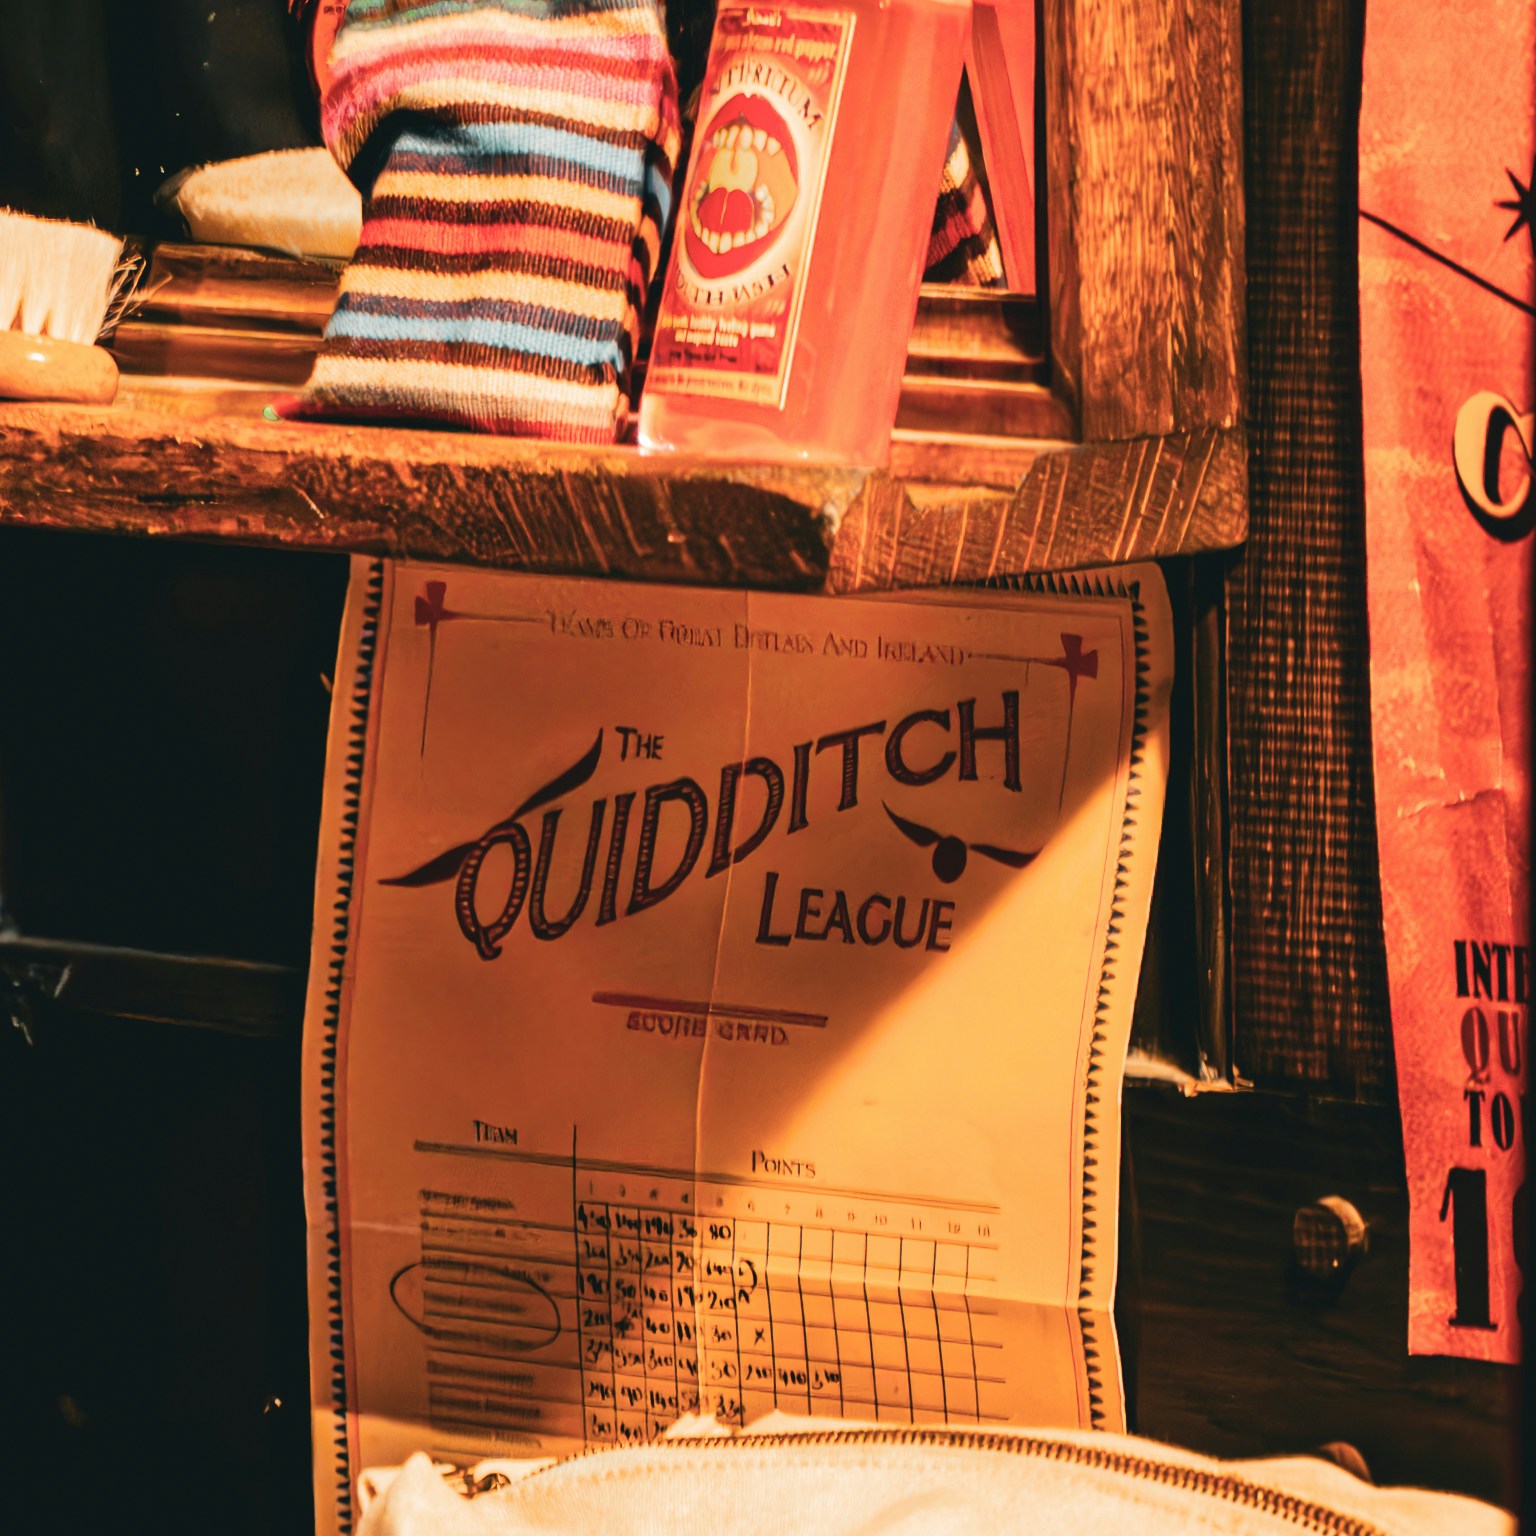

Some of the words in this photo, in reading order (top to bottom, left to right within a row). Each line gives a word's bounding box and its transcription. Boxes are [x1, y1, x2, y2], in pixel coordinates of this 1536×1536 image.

[822, 630, 868, 659] AND
[877, 635, 965, 665] IRELAND
[615, 726, 664, 762] THE
[454, 689, 1023, 961] QUIDDITCH
[754, 870, 956, 953] LEAGUE
[751, 1149, 817, 1179] POINTS
